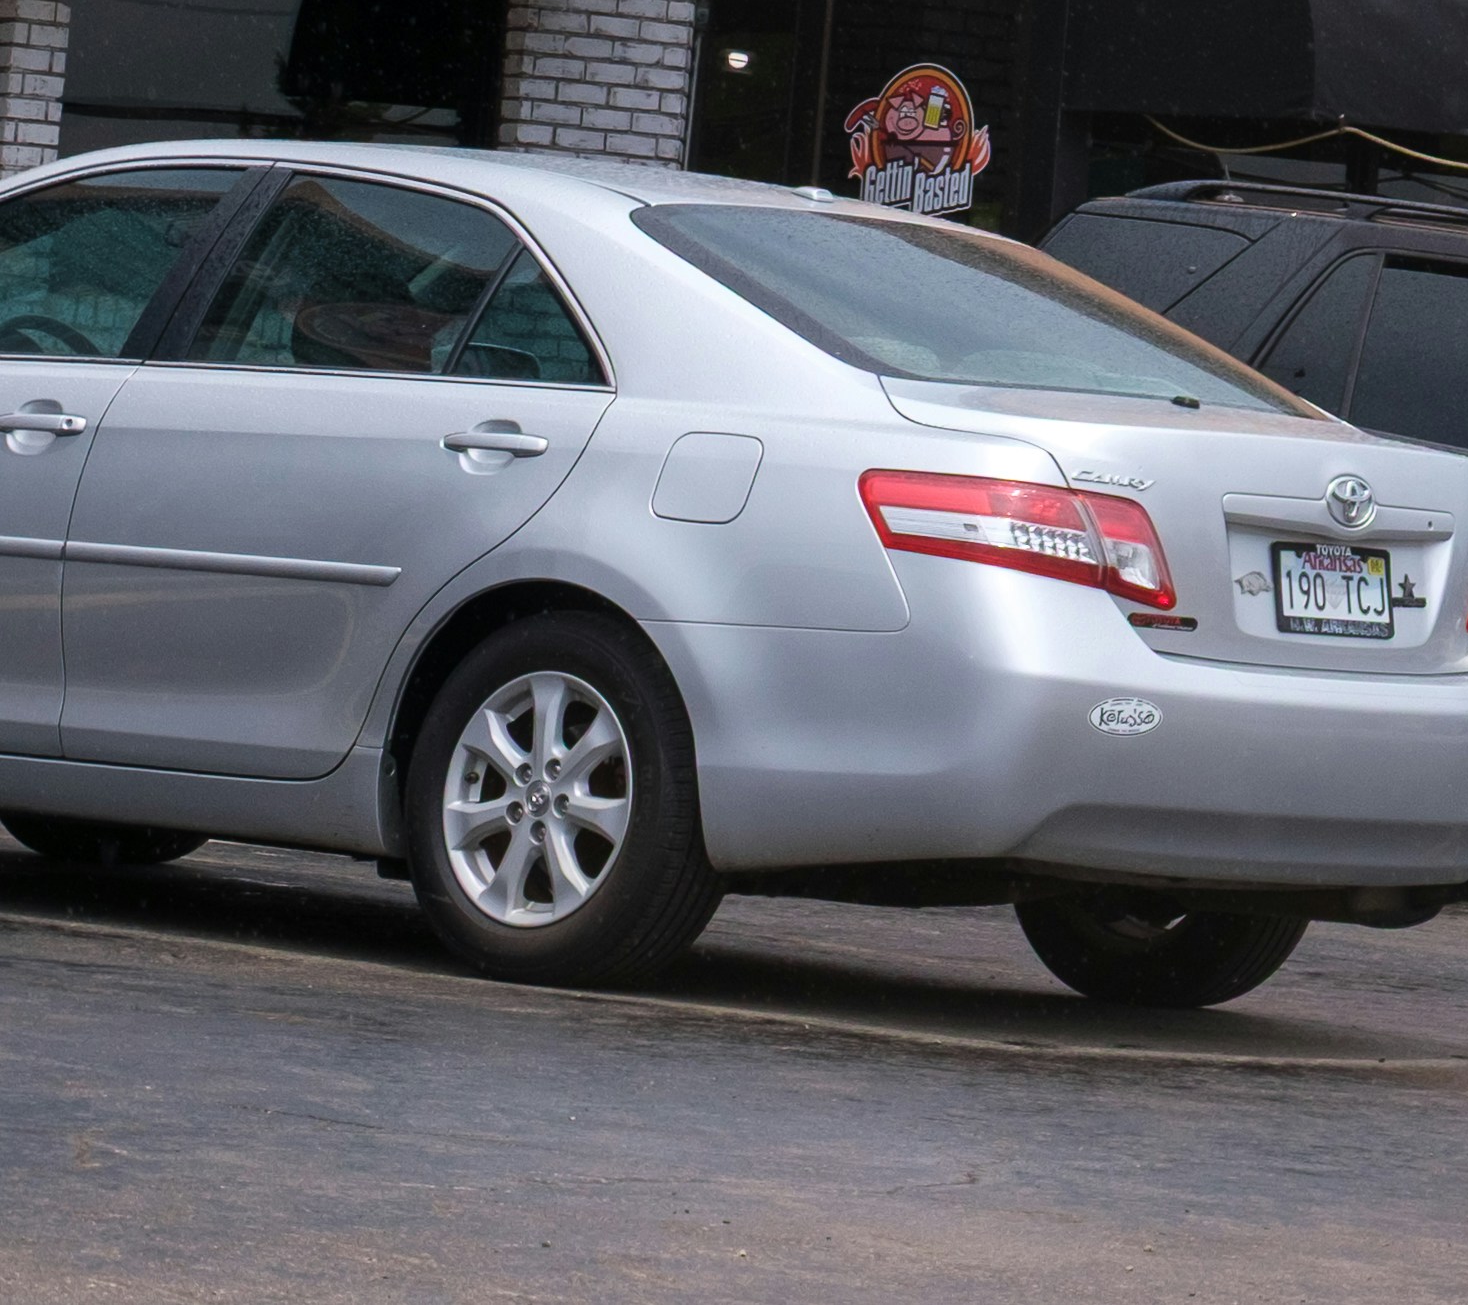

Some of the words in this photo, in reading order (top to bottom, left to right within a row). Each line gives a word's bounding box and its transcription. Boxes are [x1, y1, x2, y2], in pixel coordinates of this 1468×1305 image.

[864, 157, 919, 204] Gettin'
[914, 162, 972, 213] Basted
[1316, 544, 1352, 556] TOYOTA
[1302, 551, 1363, 574] Arkansas
[1286, 569, 1326, 612] 190
[1341, 574, 1386, 617] TCJ
[1321, 619, 1389, 638] ARKANSAS
